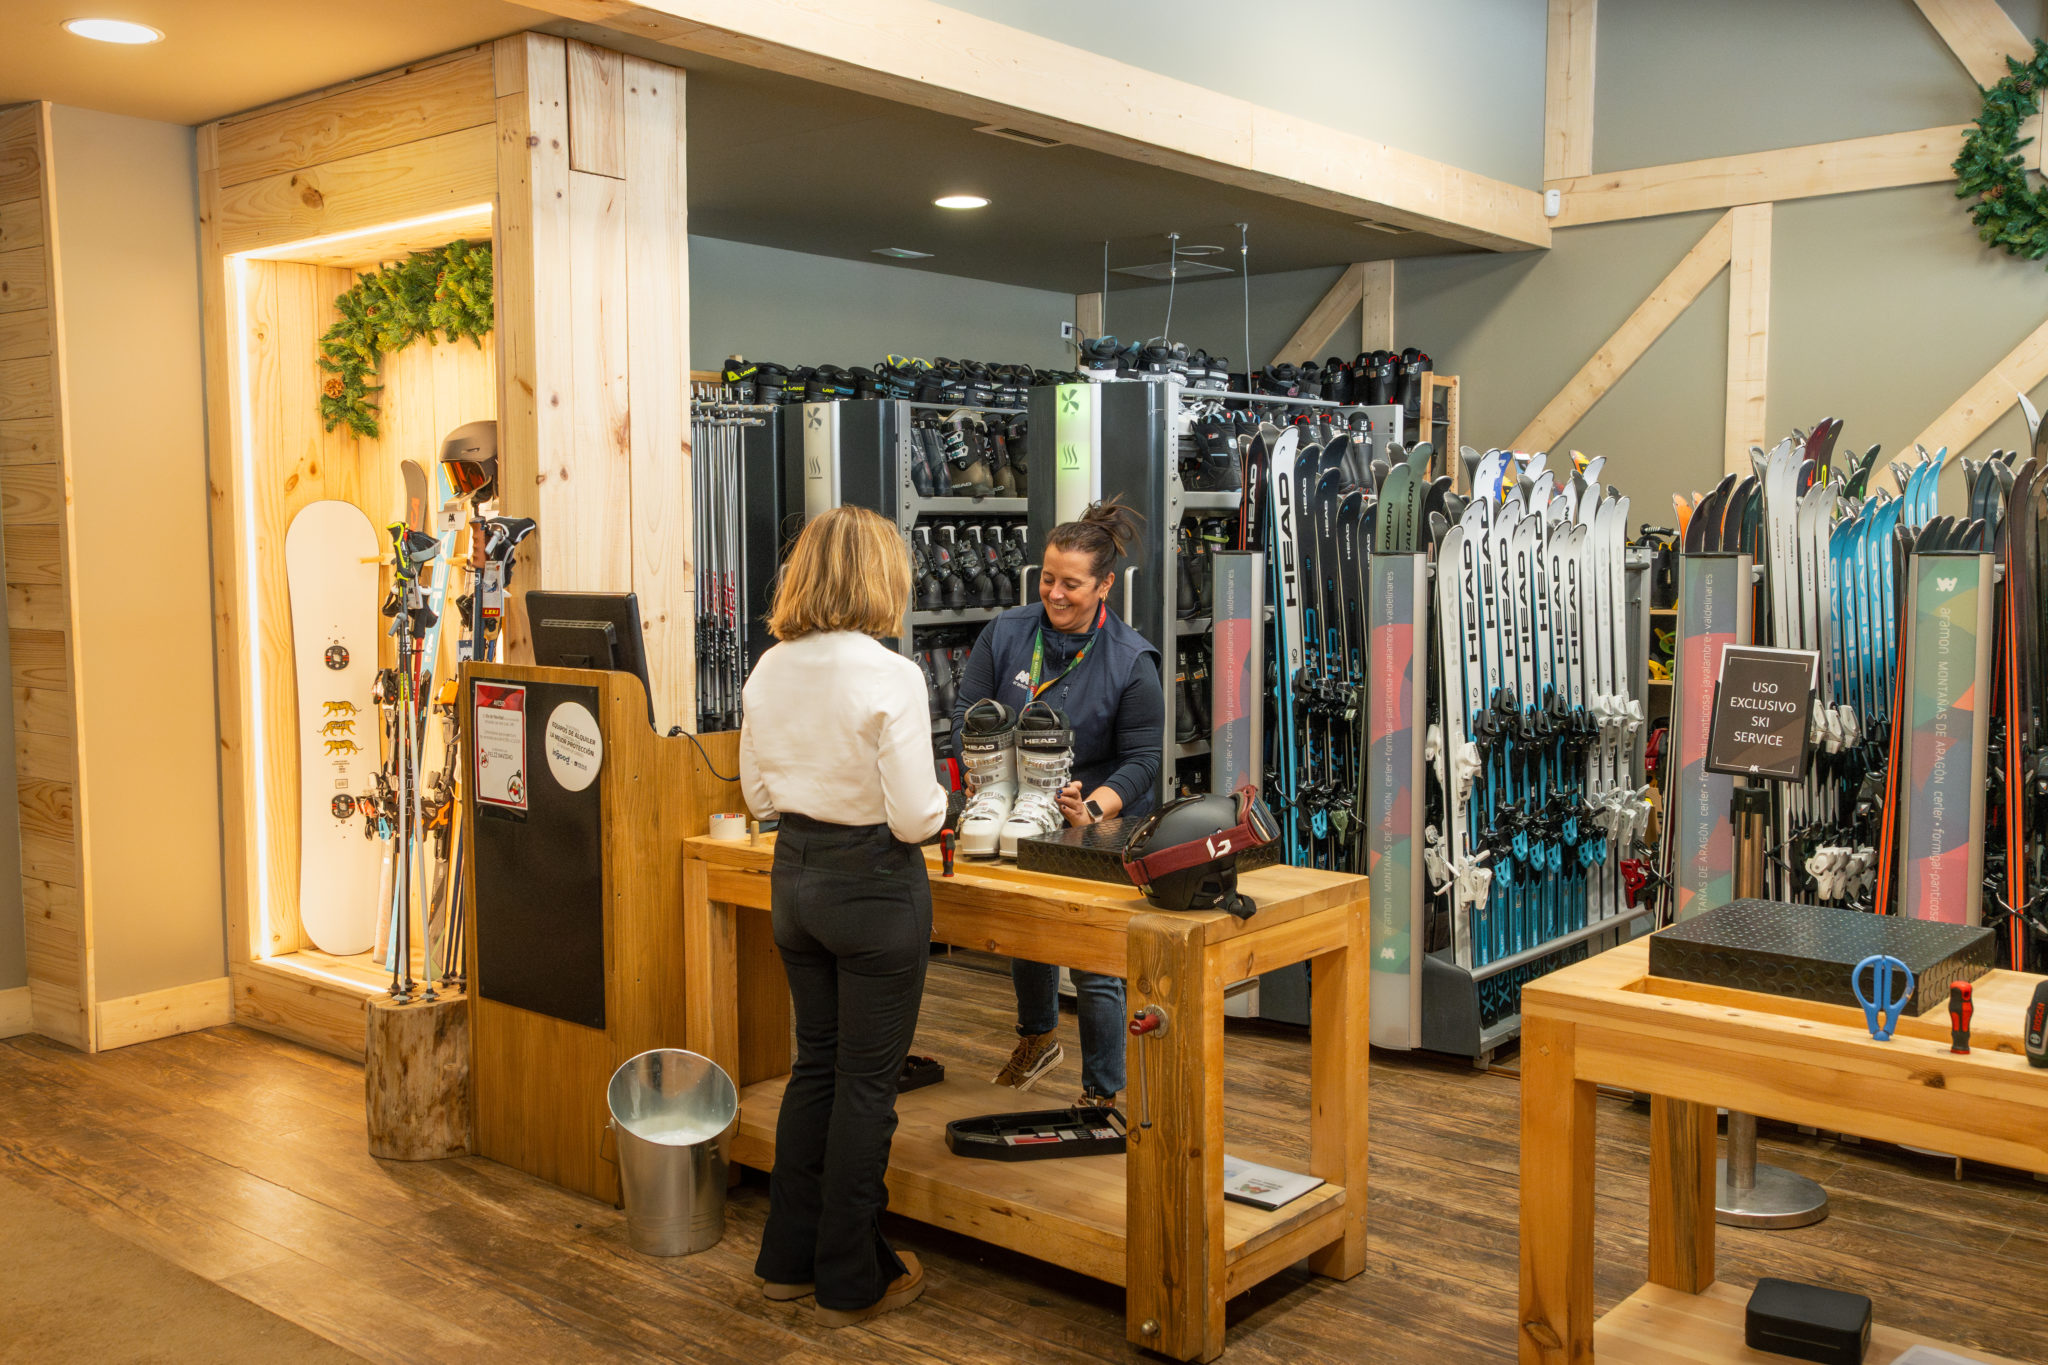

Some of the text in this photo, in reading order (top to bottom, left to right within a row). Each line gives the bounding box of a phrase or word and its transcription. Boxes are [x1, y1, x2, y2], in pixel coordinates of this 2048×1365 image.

[1247, 463, 1257, 543] HEAD
[1385, 502, 1393, 550] OMON
[1279, 472, 1297, 607] HEAD
[1481, 496, 1495, 628] HEAD
[1227, 568, 1236, 616] valdelinares
[1385, 571, 1393, 621] valdelinares
[1500, 537, 1513, 657] HEAD
[1535, 510, 1547, 631] HEAD
[1858, 535, 1869, 655] HEAD
[1884, 533, 1894, 649] HEAD
[1447, 576, 1457, 665] HEAD
[1464, 539, 1478, 662] HEAD
[1518, 551, 1530, 662] HEAD
[1553, 555, 1564, 664] HEAD
[1568, 558, 1579, 665] HEAD
[1705, 573, 1713, 630] valdelinares
[1831, 557, 1840, 681] HEAD
[1845, 557, 1856, 678] HEAD
[1872, 541, 1882, 659] HEAD
[1385, 626, 1393, 672] javalambre
[1703, 637, 1712, 688] javalambre
[1730, 696, 1797, 713] EXCLUSIVO
[1752, 681, 1778, 694] USO
[574, 732, 596, 745] ALQUILER
[1385, 678, 1393, 756] formigal-panticosa
[1733, 731, 1784, 747] SERVICE
[1751, 715, 1770, 728] SKI
[1929, 607, 1951, 922] aramon MONTAÑAS DE ARAGÓN cerler formigal-panticosa
[1700, 789, 1708, 816] cerler
[1384, 830, 1392, 842] DE
[1698, 823, 1708, 862] ARAGÓN
[1697, 882, 1708, 915] TAÑAS
[1699, 866, 1708, 879] DE
[1384, 897, 1392, 936] aramon
[2032, 1003, 2045, 1032] BOSCH
